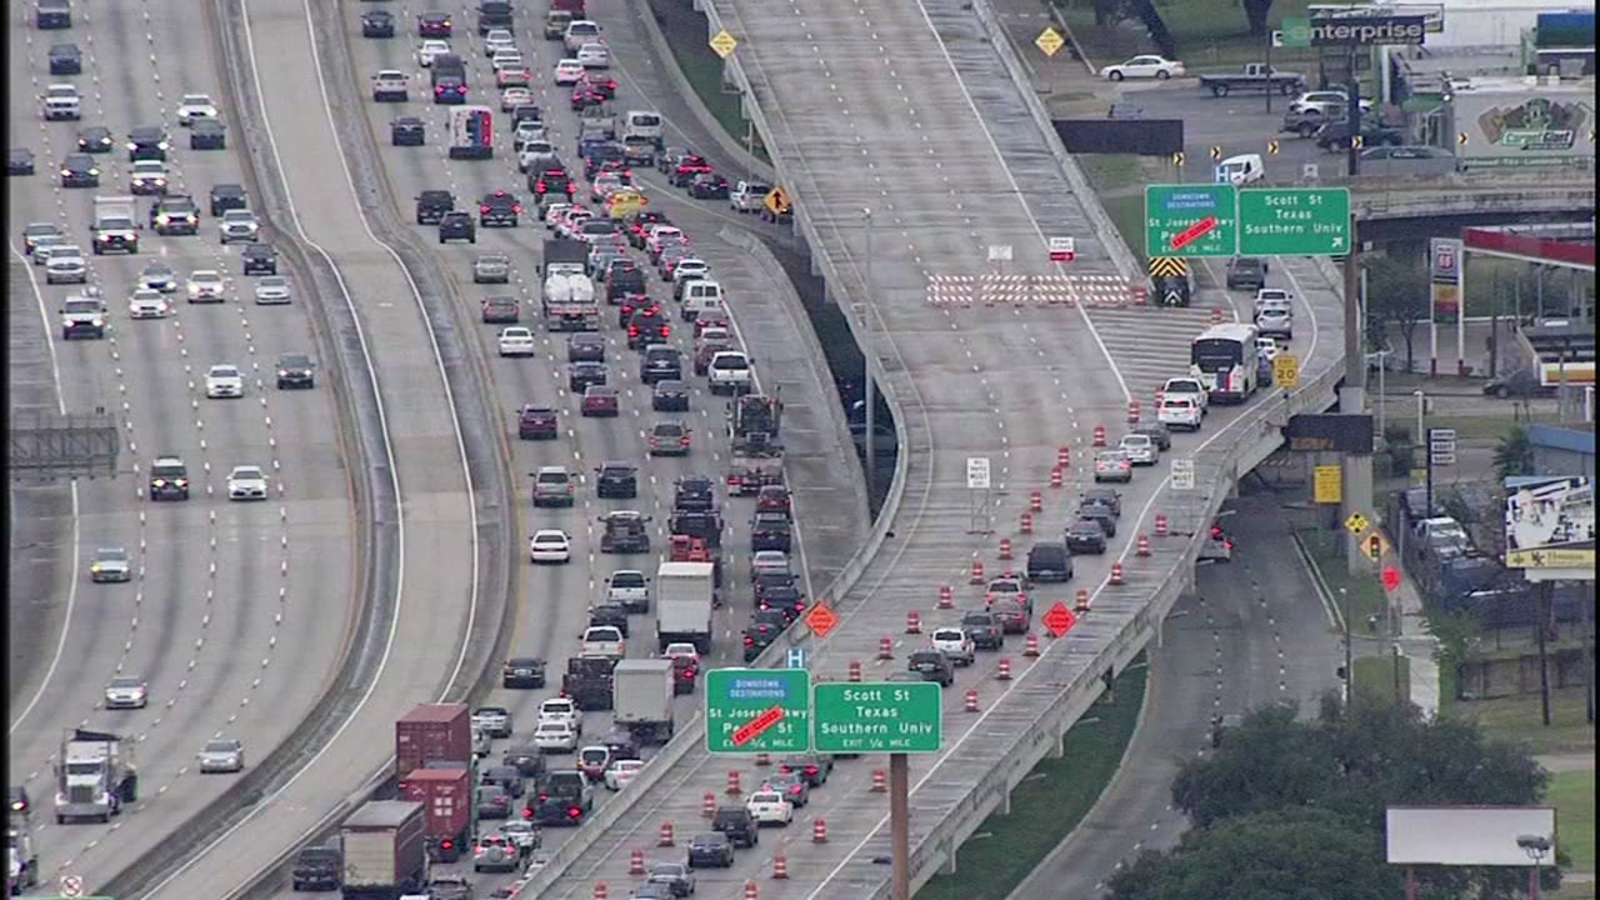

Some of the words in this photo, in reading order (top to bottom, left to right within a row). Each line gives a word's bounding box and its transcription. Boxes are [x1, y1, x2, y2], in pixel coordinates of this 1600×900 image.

[1293, 22, 1422, 42] enterprise
[1264, 194, 1298, 205] Scott
[1309, 194, 1323, 205] St
[1276, 209, 1312, 219] Texas
[1149, 217, 1160, 227] St
[1245, 224, 1304, 234] Southern
[1313, 223, 1342, 234] Univ
[1208, 230, 1222, 240] St
[1277, 369, 1295, 380] 20
[788, 650, 803, 668] H
[736, 680, 779, 688] DOWNTOWN
[730, 689, 785, 698] DESTINATIONS
[844, 690, 882, 701] Scott
[894, 690, 910, 701] St
[709, 708, 722, 718] St
[856, 706, 898, 717] Texas
[777, 722, 793, 733] St
[821, 722, 888, 734] Southern
[899, 722, 933, 734] Univ
[773, 739, 794, 747] MILE
[843, 739, 863, 747] EXIT
[889, 739, 911, 747] MILE
